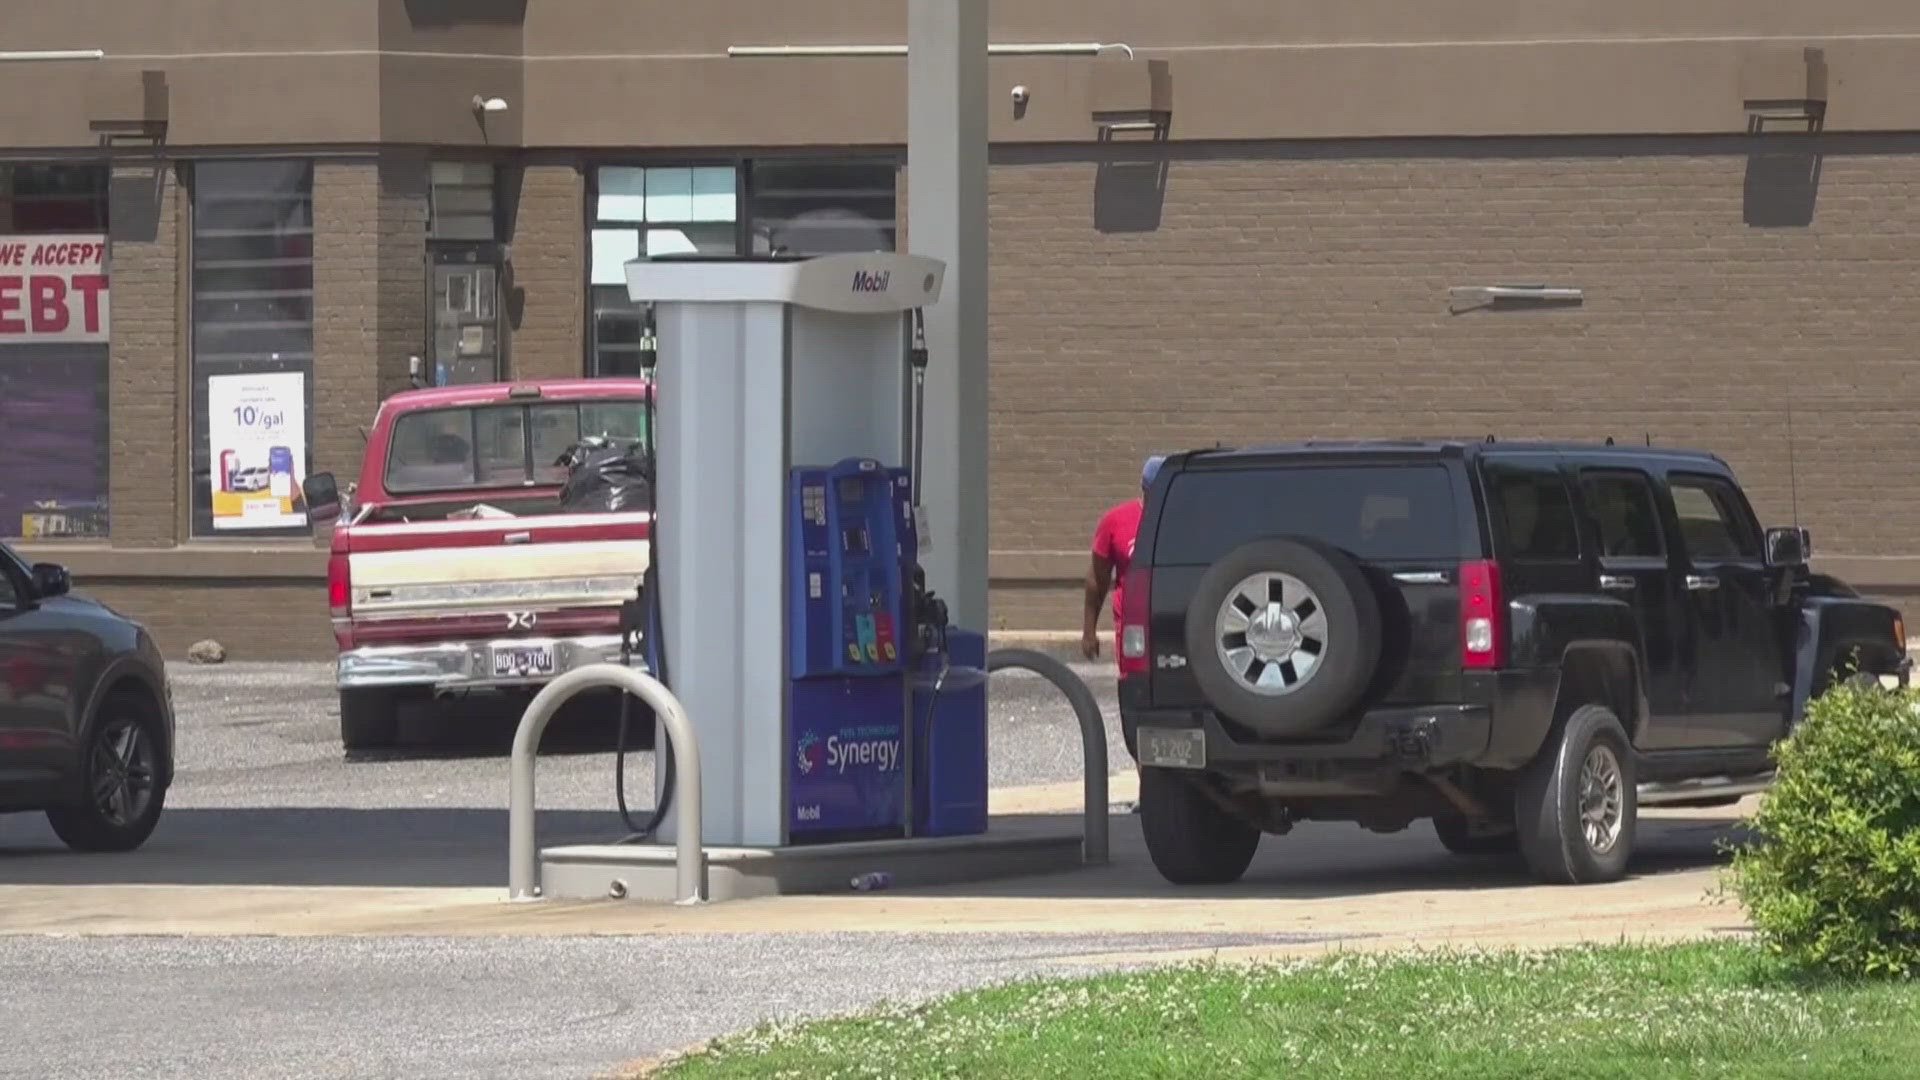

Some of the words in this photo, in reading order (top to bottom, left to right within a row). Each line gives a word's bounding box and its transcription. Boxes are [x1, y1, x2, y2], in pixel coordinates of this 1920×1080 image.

[0, 243, 26, 266] WE
[31, 242, 105, 266] ACCEPT
[852, 270, 890, 293] Mobil
[0, 274, 110, 334] EBT
[827, 735, 900, 774] Synergy
[797, 804, 820, 821] Mobil
